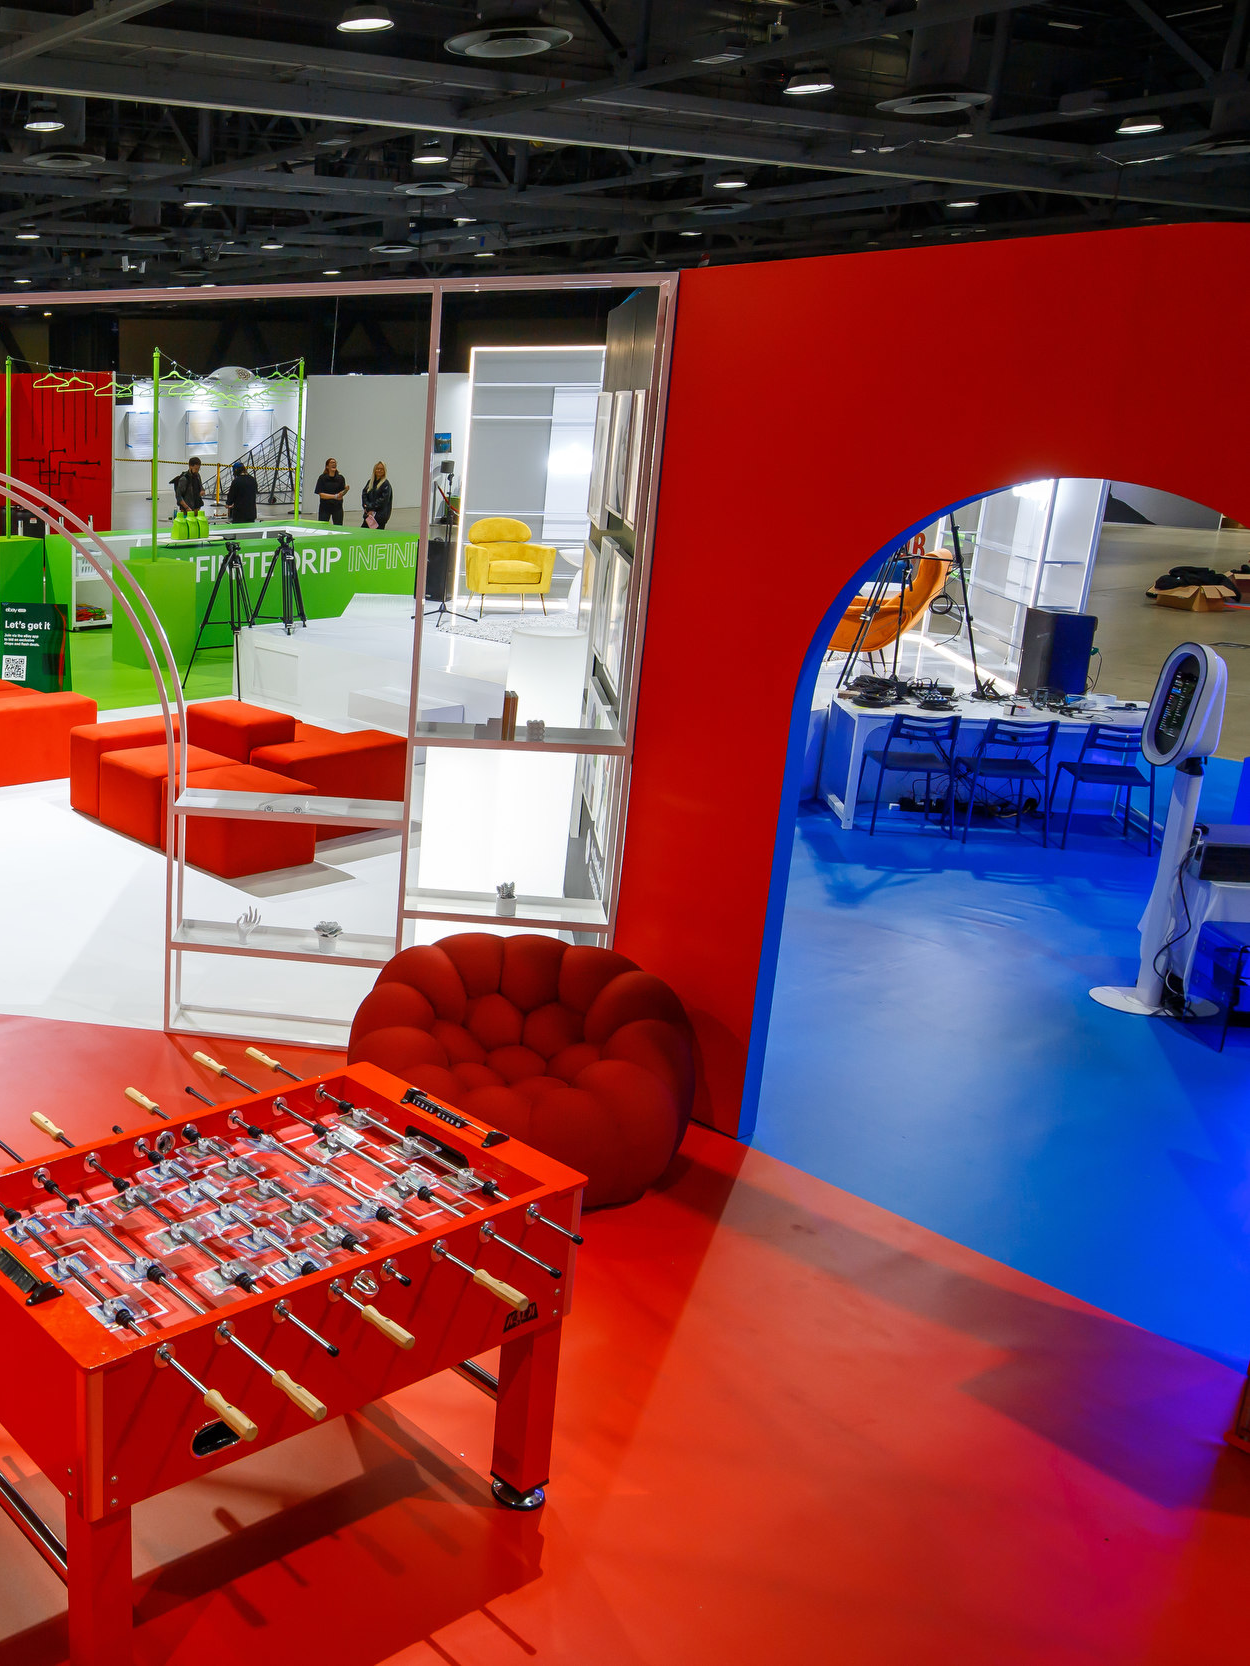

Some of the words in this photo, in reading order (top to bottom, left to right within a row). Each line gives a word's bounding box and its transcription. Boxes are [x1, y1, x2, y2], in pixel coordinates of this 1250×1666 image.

[348, 542, 418, 572] INFINI
[5, 620, 26, 629] Let's
[27, 622, 43, 631] get
[44, 622, 51, 630] it
